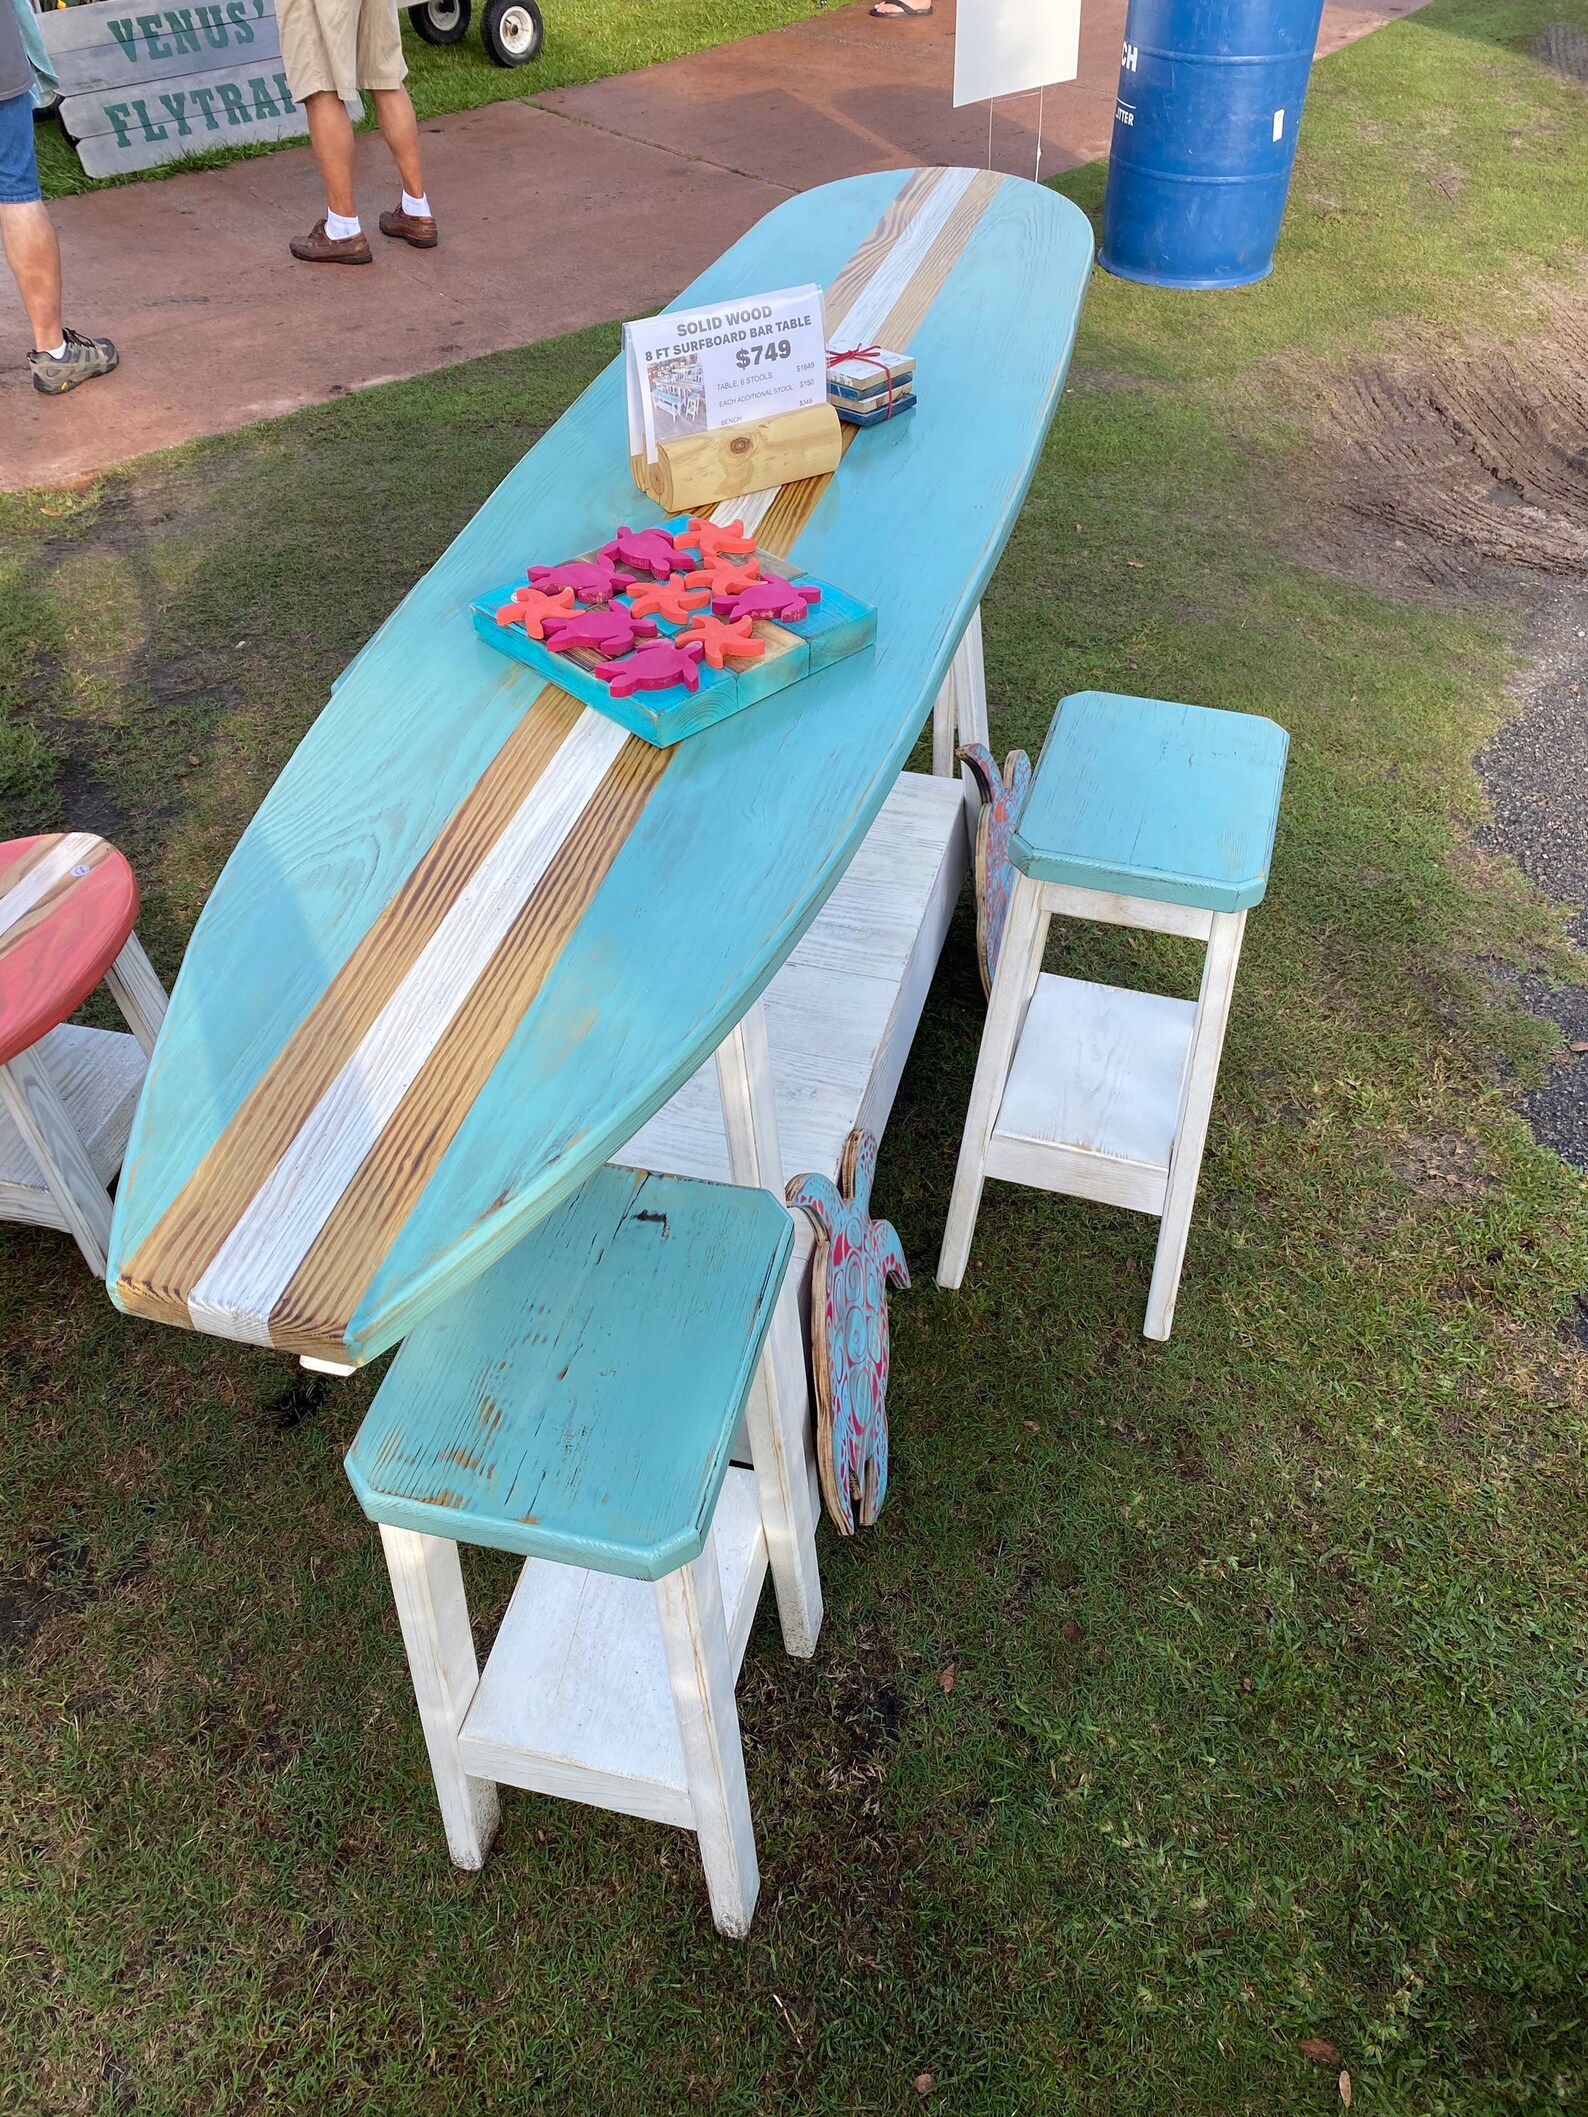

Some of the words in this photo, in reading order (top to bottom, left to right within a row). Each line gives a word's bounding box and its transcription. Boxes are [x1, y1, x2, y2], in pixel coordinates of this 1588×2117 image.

[107, 0, 265, 62] VENUS'
[1116, 107, 1135, 126] ITTER
[677, 317, 723, 337] SOLID
[725, 305, 772, 327] WOOD
[645, 351, 653, 362] 8
[656, 347, 670, 360] FT
[673, 330, 747, 356] SURFBOARD
[750, 324, 774, 339] BAR
[775, 315, 812, 333] TABLE
[736, 339, 791, 370] $749
[716, 381, 739, 391] TABLE,
[740, 378, 745, 386] 6
[746, 372, 773, 385] STOOLS
[796, 362, 815, 372] $1649
[719, 397, 737, 407] EACH
[737, 389, 773, 403] ADDITIONAL
[773, 384, 793, 394] STOOL
[799, 379, 815, 388] $150
[720, 416, 742, 425] BENCH
